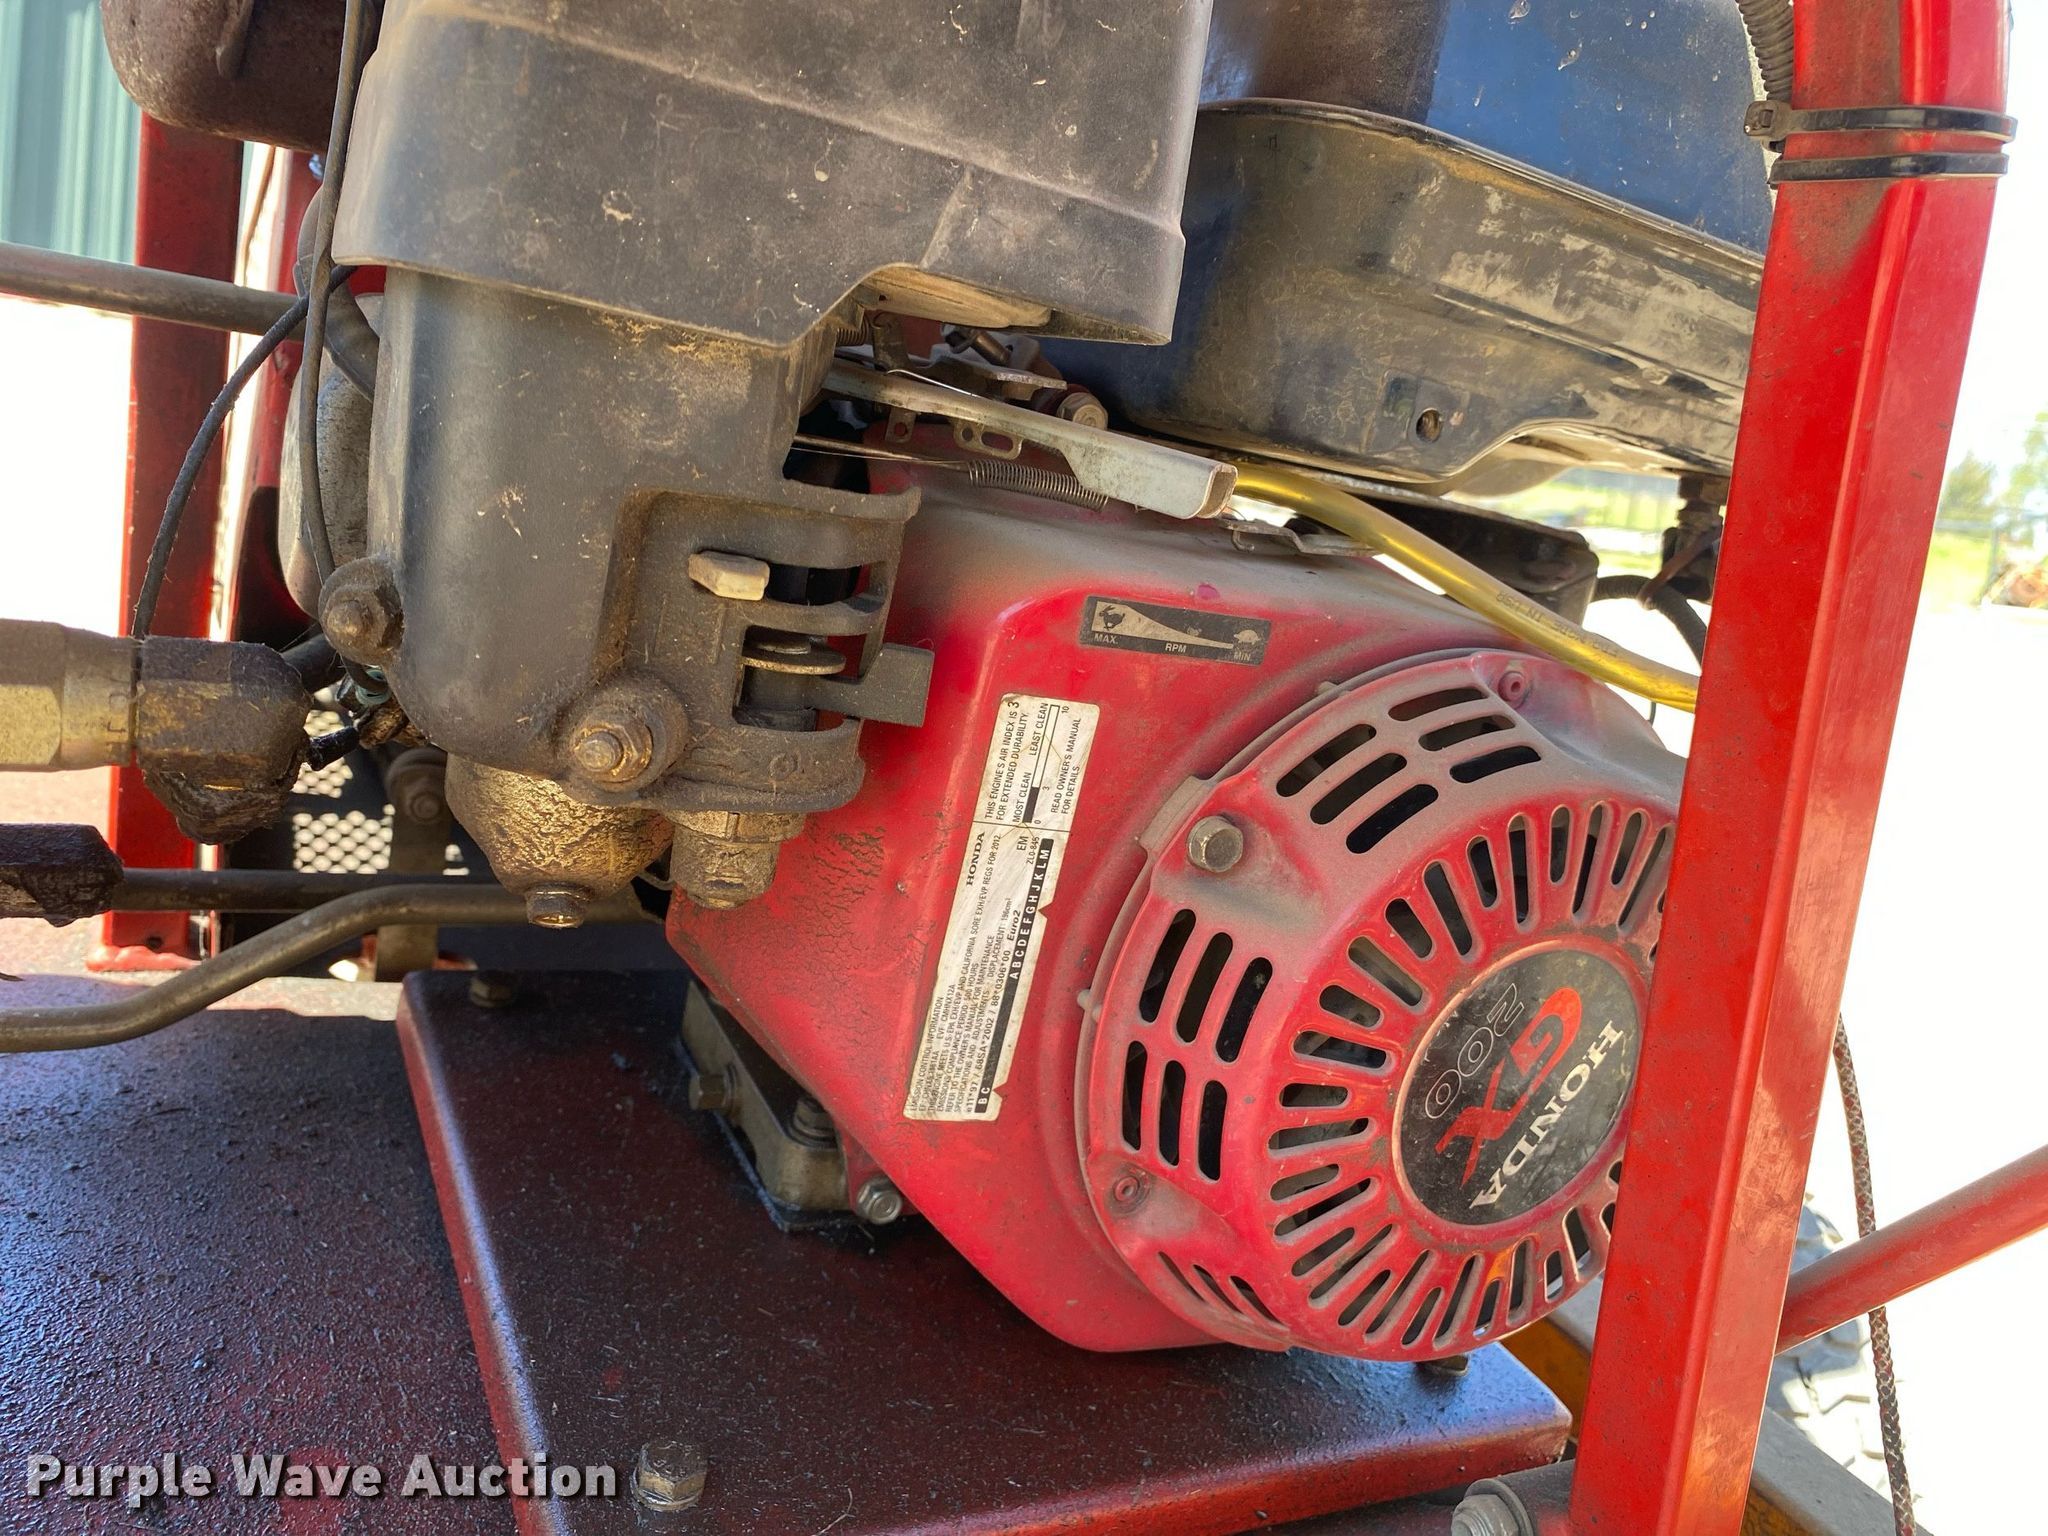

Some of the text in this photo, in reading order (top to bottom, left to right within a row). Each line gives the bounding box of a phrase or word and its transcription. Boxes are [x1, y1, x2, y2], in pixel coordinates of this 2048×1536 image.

[1094, 633, 1118, 645] MAX.
[1165, 642, 1187, 653] RPM
[1008, 700, 1020, 708] 3
[1009, 710, 1017, 718] IS
[1062, 705, 1069, 713] 10
[1002, 721, 1015, 745] INDEX
[1029, 702, 1048, 755] LEAST CLEAN
[998, 747, 1009, 761] AIR
[1051, 792, 1062, 813] READ
[1066, 717, 1080, 752] MANUAL
[1001, 761, 1017, 802] EXTENDED
[1013, 771, 1031, 822] MOST CLEAN
[1062, 799, 1071, 814] FOR
[985, 801, 996, 818] THIS
[997, 804, 1006, 820] FOR
[991, 834, 1000, 849] 2012
[1016, 835, 1029, 850] EM
[966, 831, 985, 886] HONDA
[987, 851, 996, 864] FOR
[982, 866, 993, 884] REGS
[975, 886, 988, 914] EXH/EVP
[970, 917, 981, 934] SORE
[1007, 909, 1021, 940] Euro2
[961, 936, 976, 974] CALIFORNIA
[976, 935, 994, 984] MAINTENANCE
[957, 976, 967, 990] AND
[967, 962, 978, 986] HOURS
[964, 988, 972, 1000] 500
[973, 986, 982, 999] FOR
[950, 991, 963, 1019] EXH/EVP
[965, 1002, 978, 1031] MANUAL
[947, 1021, 956, 1033] EPA
[911, 996, 943, 1110] EMISSION CONTROL INFORMATION
[938, 1049, 949, 1070] MEETS
[946, 1031, 962, 1073] COMPLIANCE
[955, 1061, 972, 1112] SPECIFICATIONS
[967, 1044, 976, 1058] AND
[972, 990, 990, 1039] ADJUSTMENTS
[1425, 983, 1524, 1119] 200
[954, 1066, 962, 1078] THE
[937, 1075, 951, 1111] EMISSIONS
[951, 1080, 959, 1089] TO
[1435, 987, 1582, 1190] GX
[946, 1092, 956, 1111] REFER
[1469, 1020, 1624, 1209] HONDA
